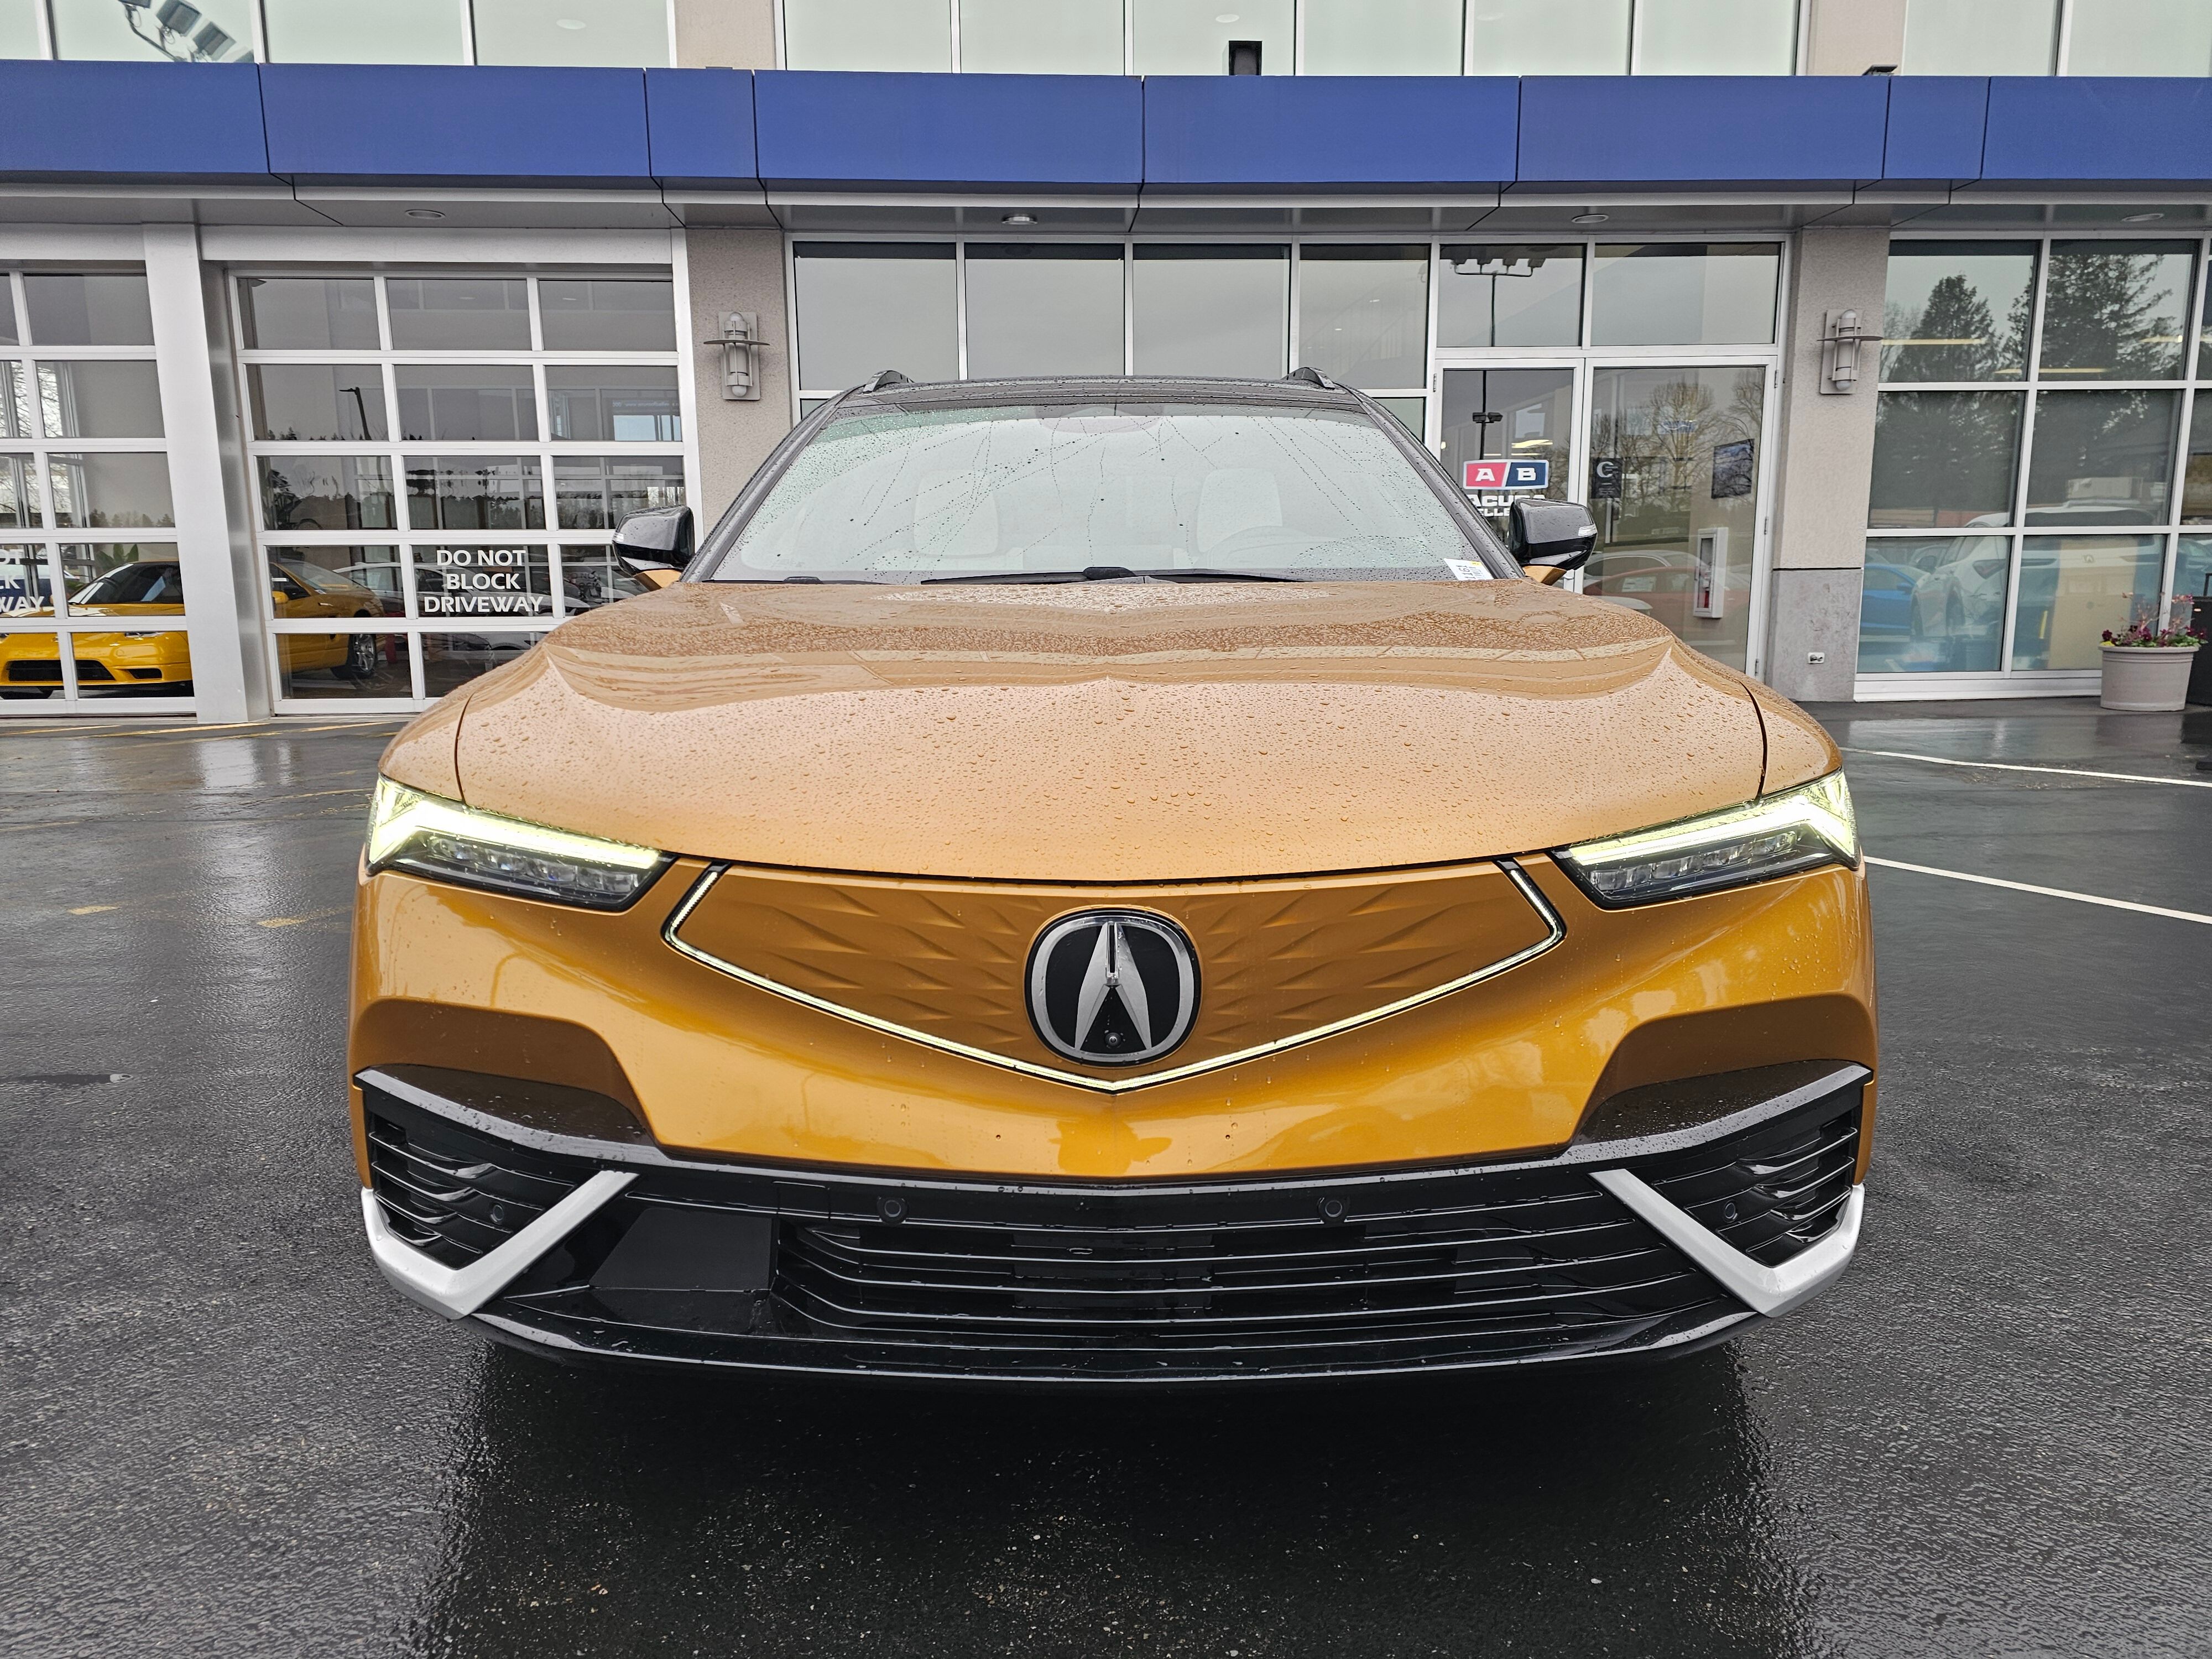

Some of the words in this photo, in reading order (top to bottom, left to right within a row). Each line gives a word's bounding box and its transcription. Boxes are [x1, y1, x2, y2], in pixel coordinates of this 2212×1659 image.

[1475, 468, 1495, 481] A
[1516, 468, 1536, 481] B
[436, 550, 471, 566] DO
[477, 550, 526, 566] NOT
[446, 573, 521, 590] BLOCK
[424, 596, 544, 613] DRIVEWAY
